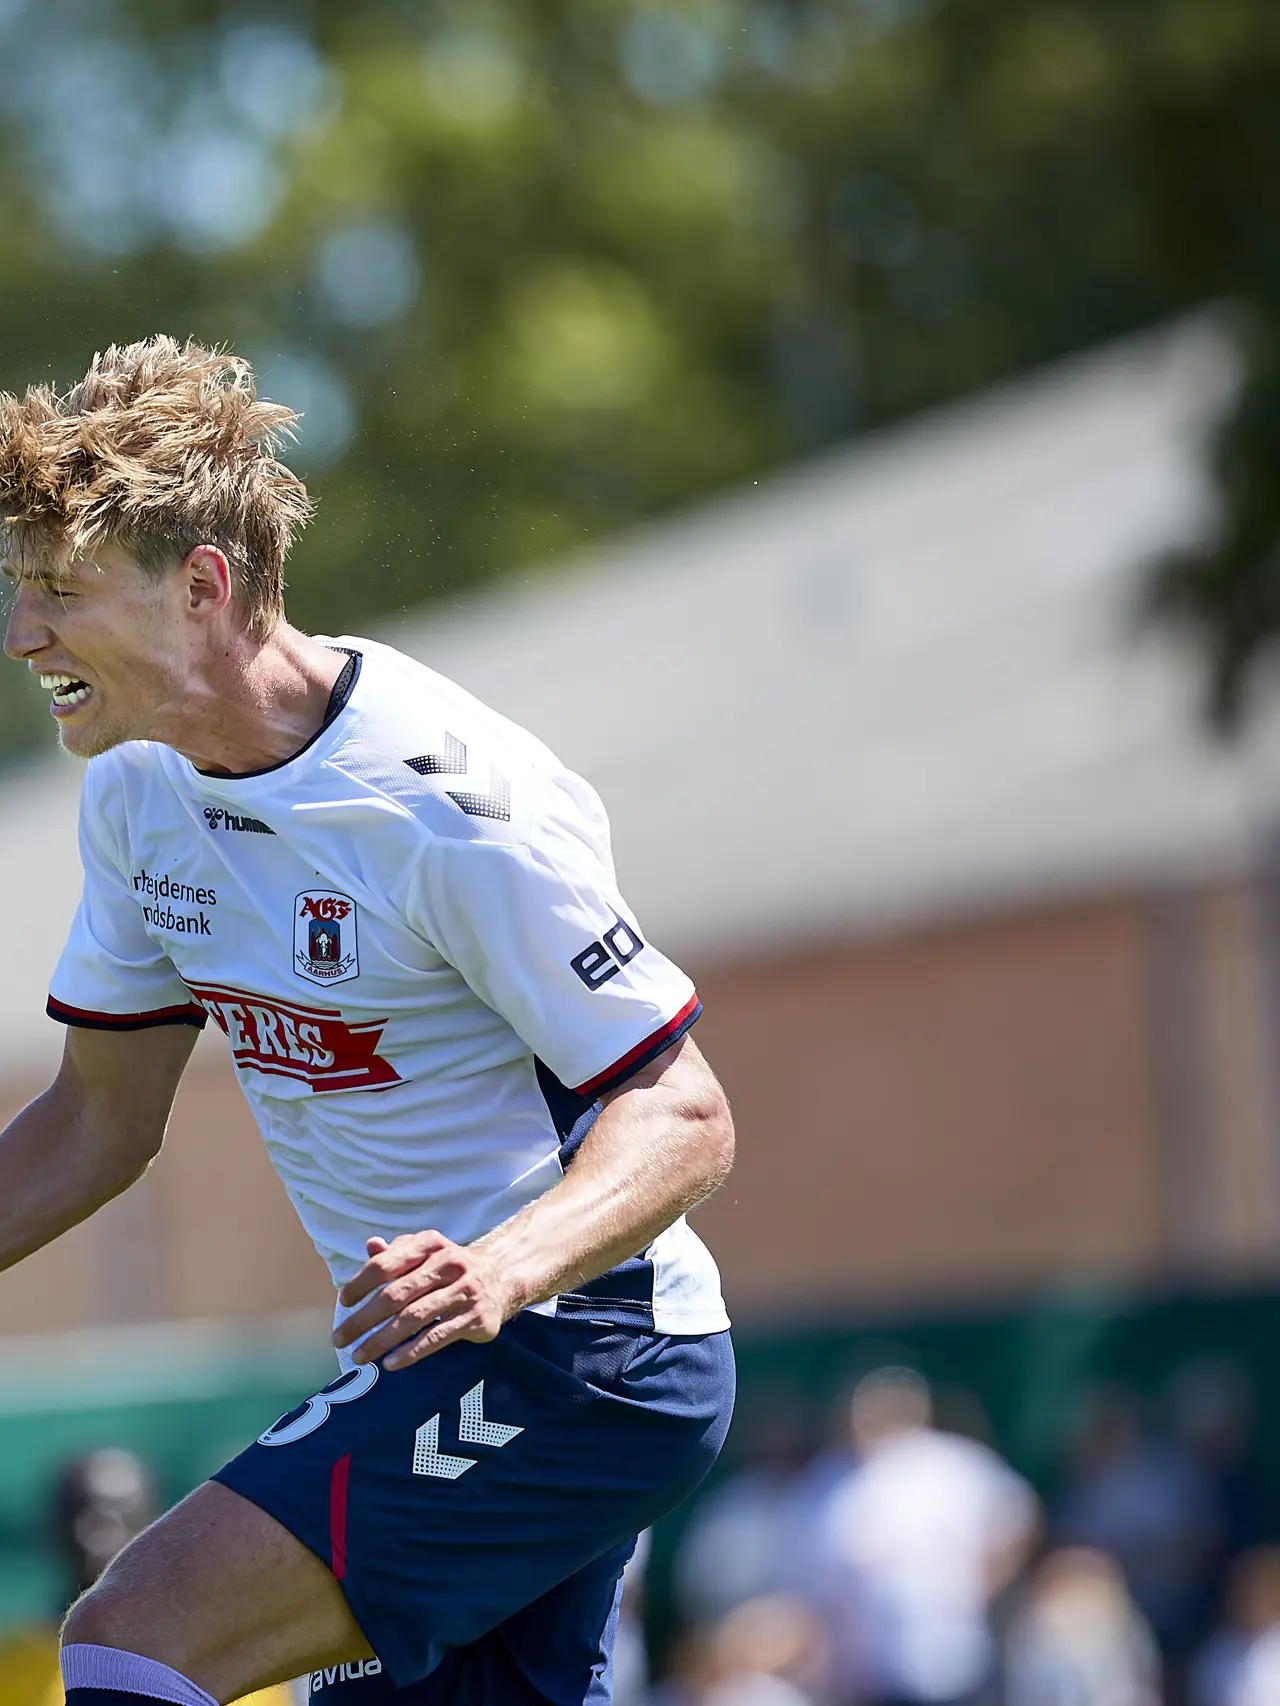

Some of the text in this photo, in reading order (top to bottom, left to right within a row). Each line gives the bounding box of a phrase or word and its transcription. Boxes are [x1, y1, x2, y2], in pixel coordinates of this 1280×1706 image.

[143, 903, 212, 936] ndsbank
[299, 896, 352, 922] AGF
[307, 965, 343, 977] AARHUS
